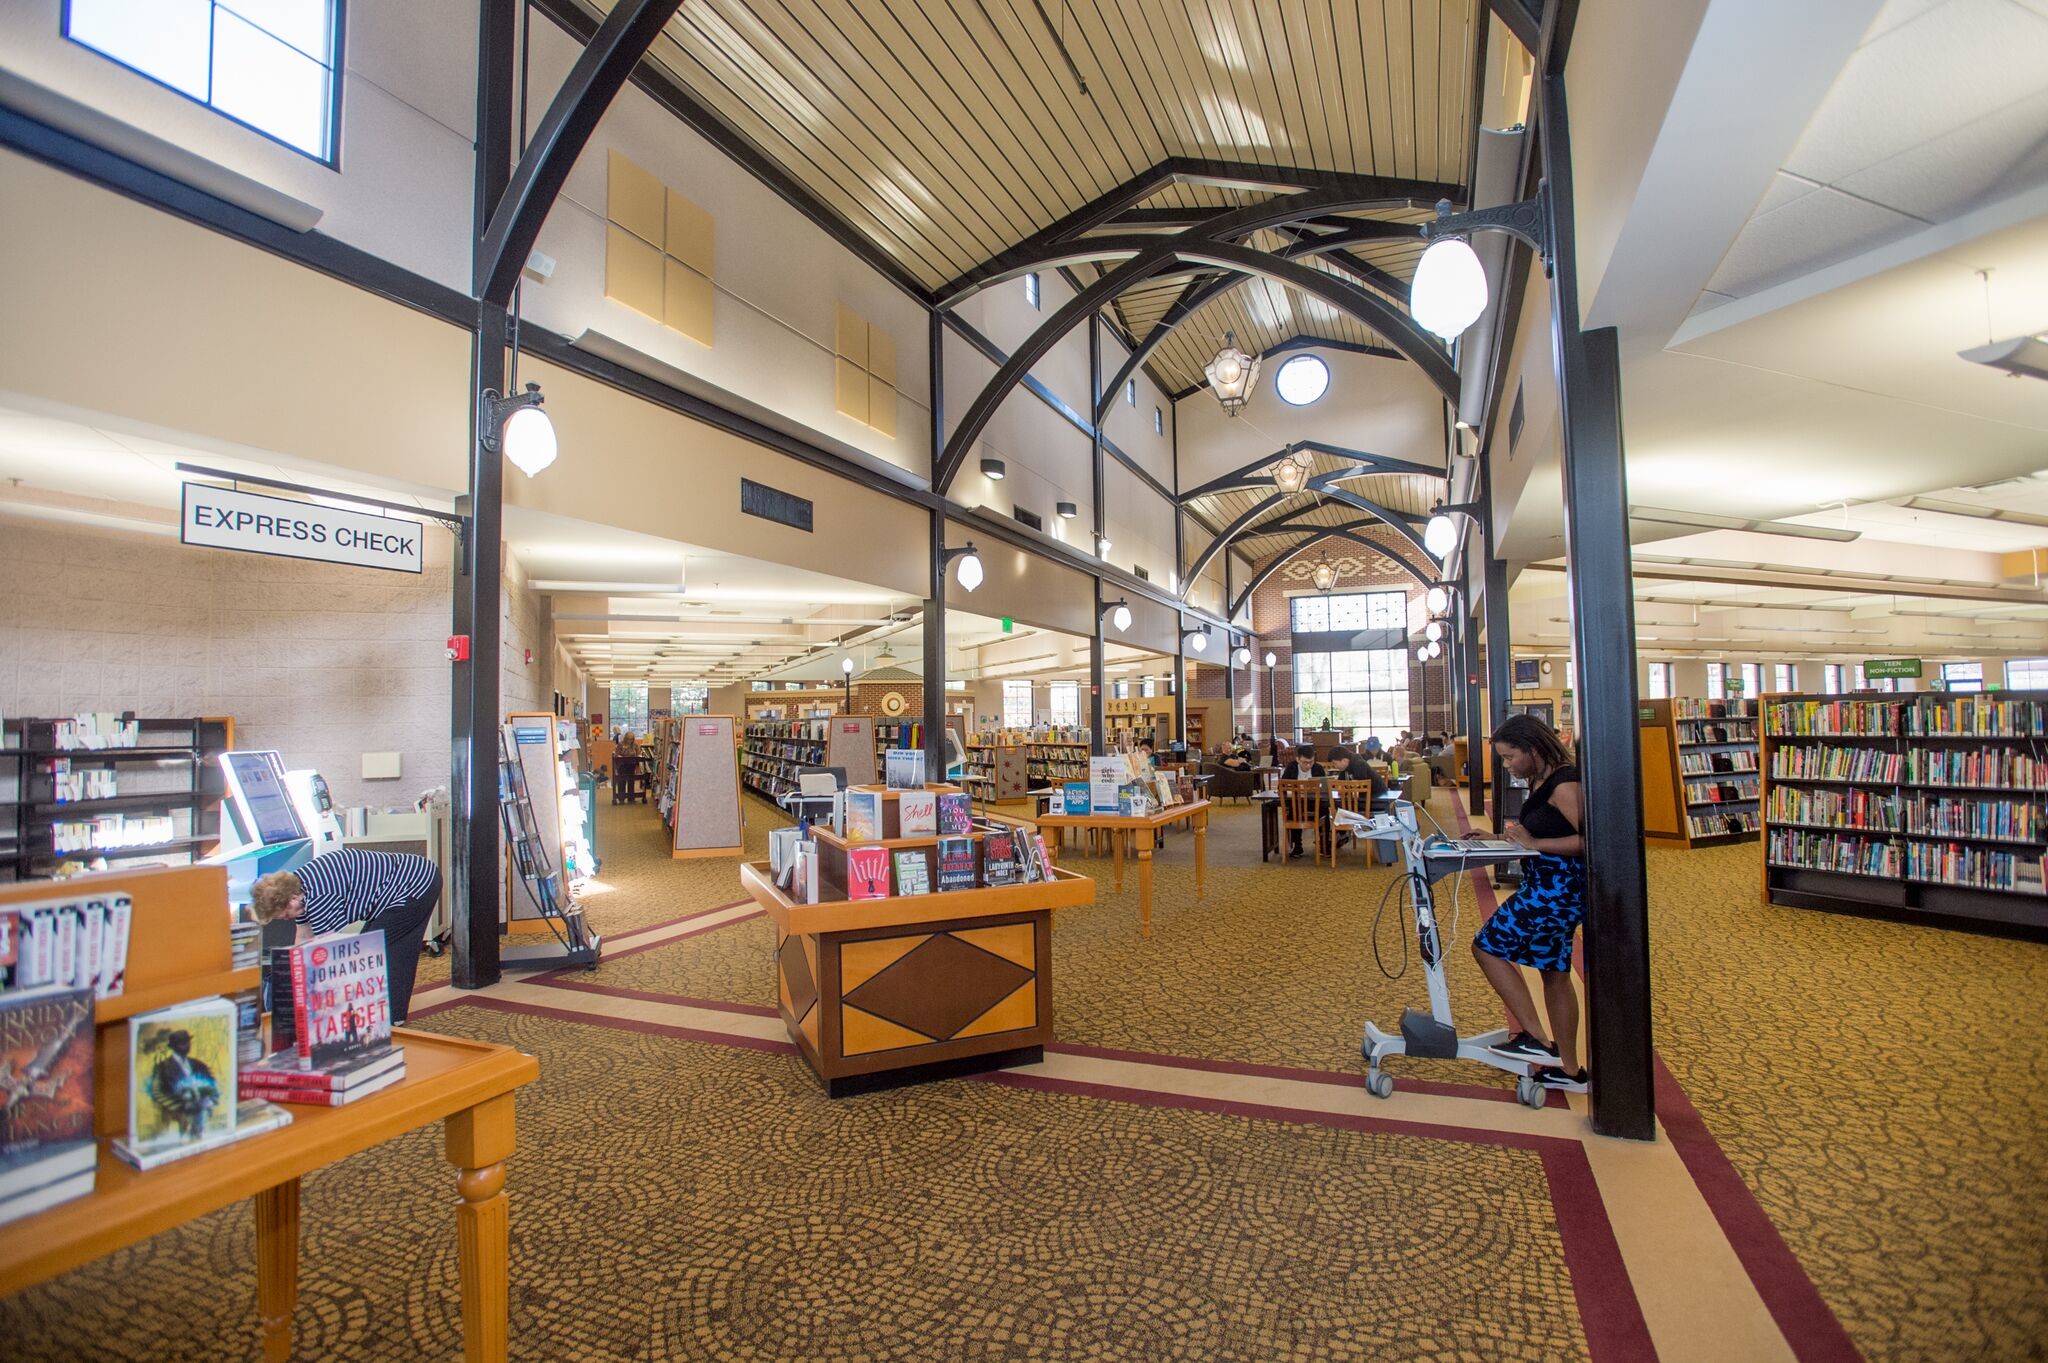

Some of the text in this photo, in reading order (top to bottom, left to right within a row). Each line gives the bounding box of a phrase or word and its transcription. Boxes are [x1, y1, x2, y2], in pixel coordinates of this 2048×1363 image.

[194, 505, 415, 556] EXPRESS CHECK
[904, 802, 934, 822] Shell
[941, 873, 975, 884] Abandoned
[988, 861, 1014, 871] LABYRINTH
[995, 869, 1008, 877] INDEX
[332, 941, 360, 960] IRIS
[310, 953, 384, 985] JOHANSEN
[310, 974, 385, 1012] NO EASY
[0, 998, 90, 1030] RRILYN
[312, 1000, 387, 1041] TARGET
